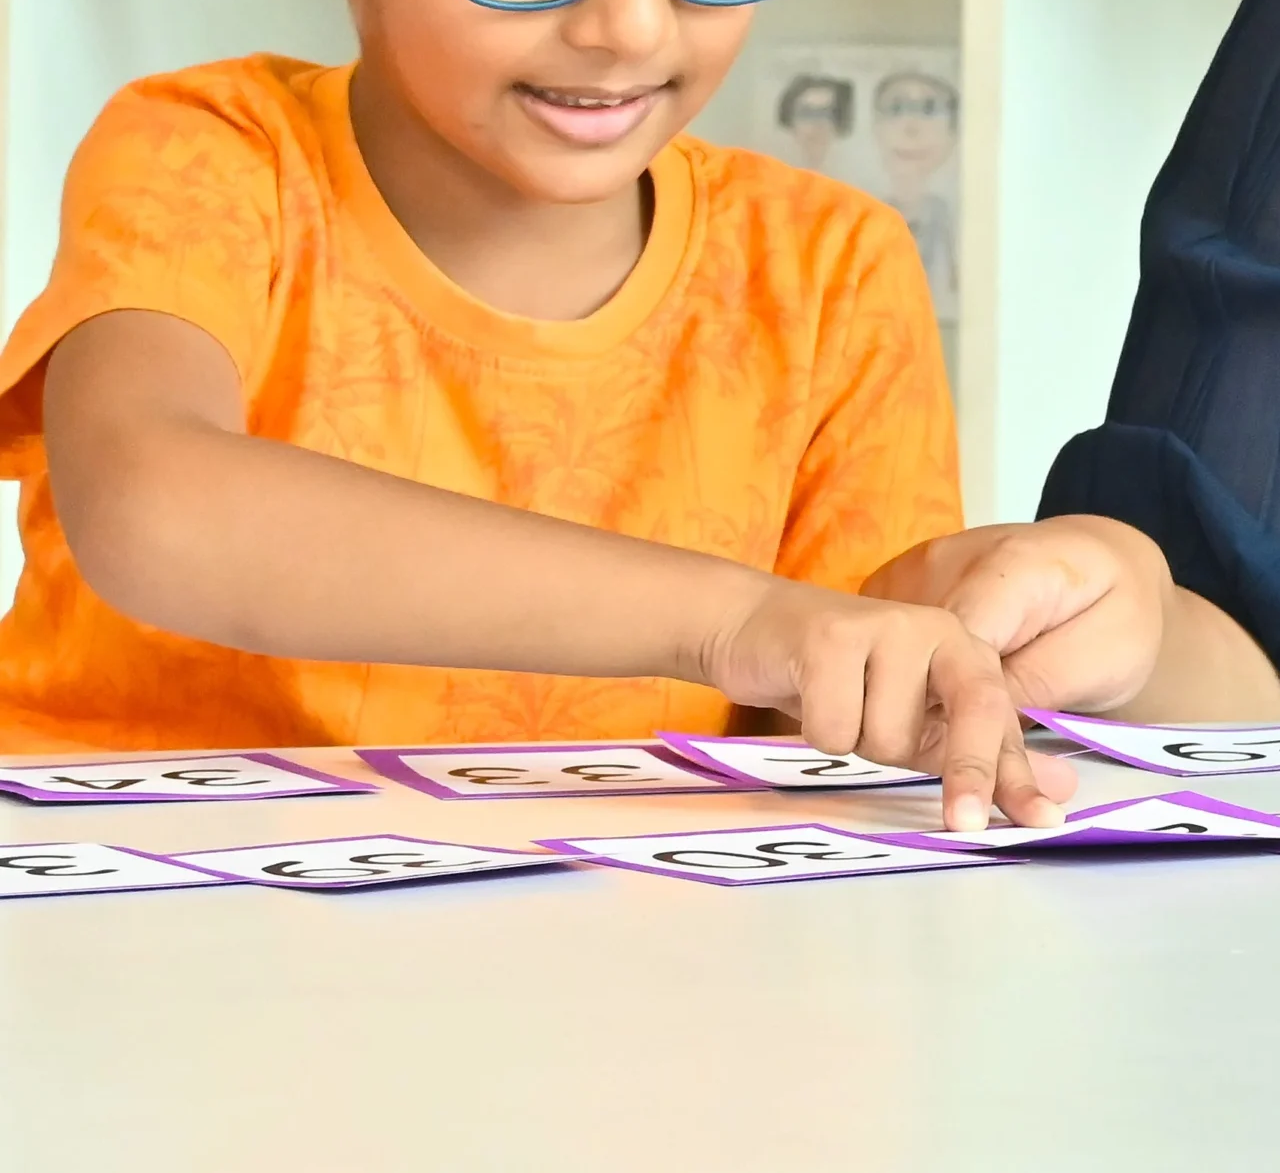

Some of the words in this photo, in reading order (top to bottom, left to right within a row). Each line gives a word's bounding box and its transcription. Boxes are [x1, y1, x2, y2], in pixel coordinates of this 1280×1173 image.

[447, 763, 661, 785] 33
[763, 758, 882, 777] 2
[45, 768, 270, 790] 34
[261, 853, 490, 878] 39
[652, 841, 890, 869] 30
